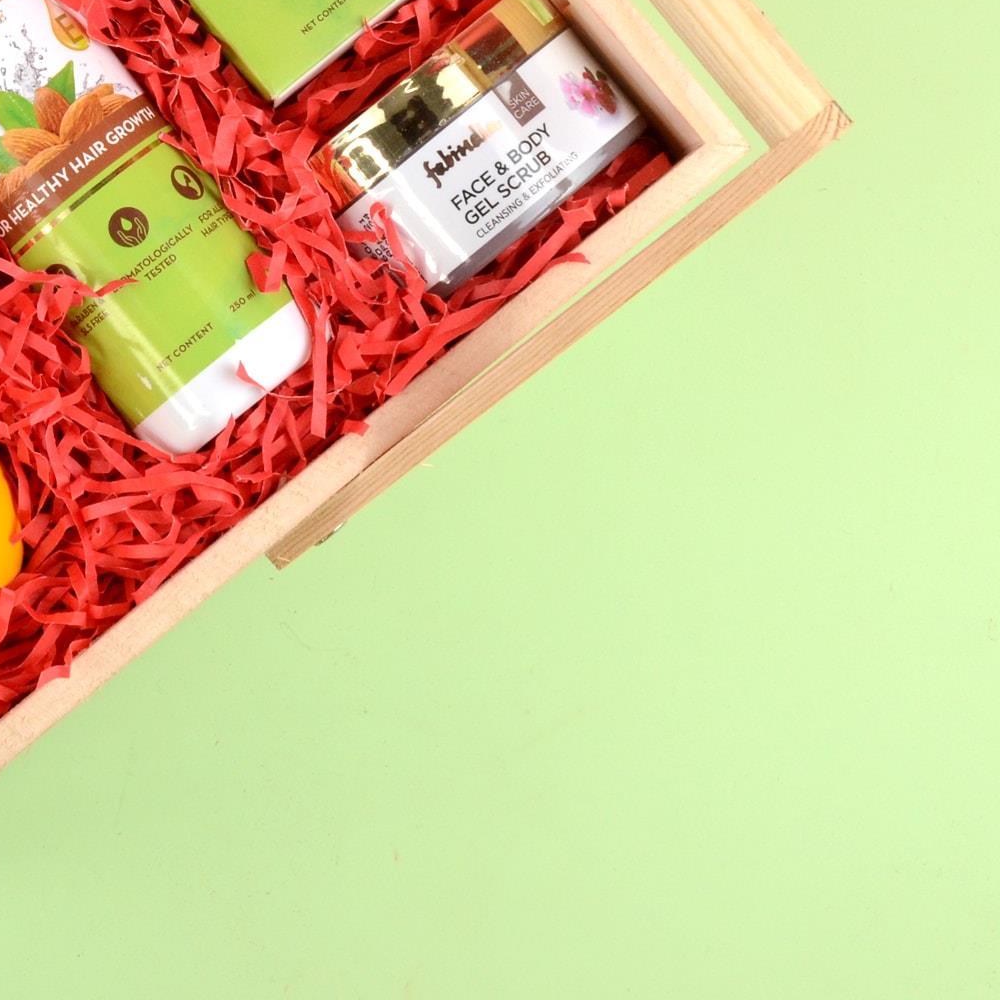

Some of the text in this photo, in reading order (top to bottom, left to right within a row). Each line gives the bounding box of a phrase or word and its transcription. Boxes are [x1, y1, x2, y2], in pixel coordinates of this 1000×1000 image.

[301, 21, 318, 35] NET
[507, 88, 530, 109] SKIN
[513, 97, 540, 120] CARE
[9, 168, 70, 224] HEALTHY
[69, 141, 108, 174] HAIR
[105, 107, 155, 146] GROWTH
[450, 123, 550, 210] FACE & BODY
[464, 151, 552, 224] GEL SCRUB
[476, 150, 579, 238] CLEANSING & EXFOLIATING
[198, 209, 214, 224] FOR
[201, 223, 218, 237] HAIR
[144, 255, 177, 281] TESTED
[229, 291, 256, 313] 250 ml
[156, 322, 214, 372] NET CONTENT
